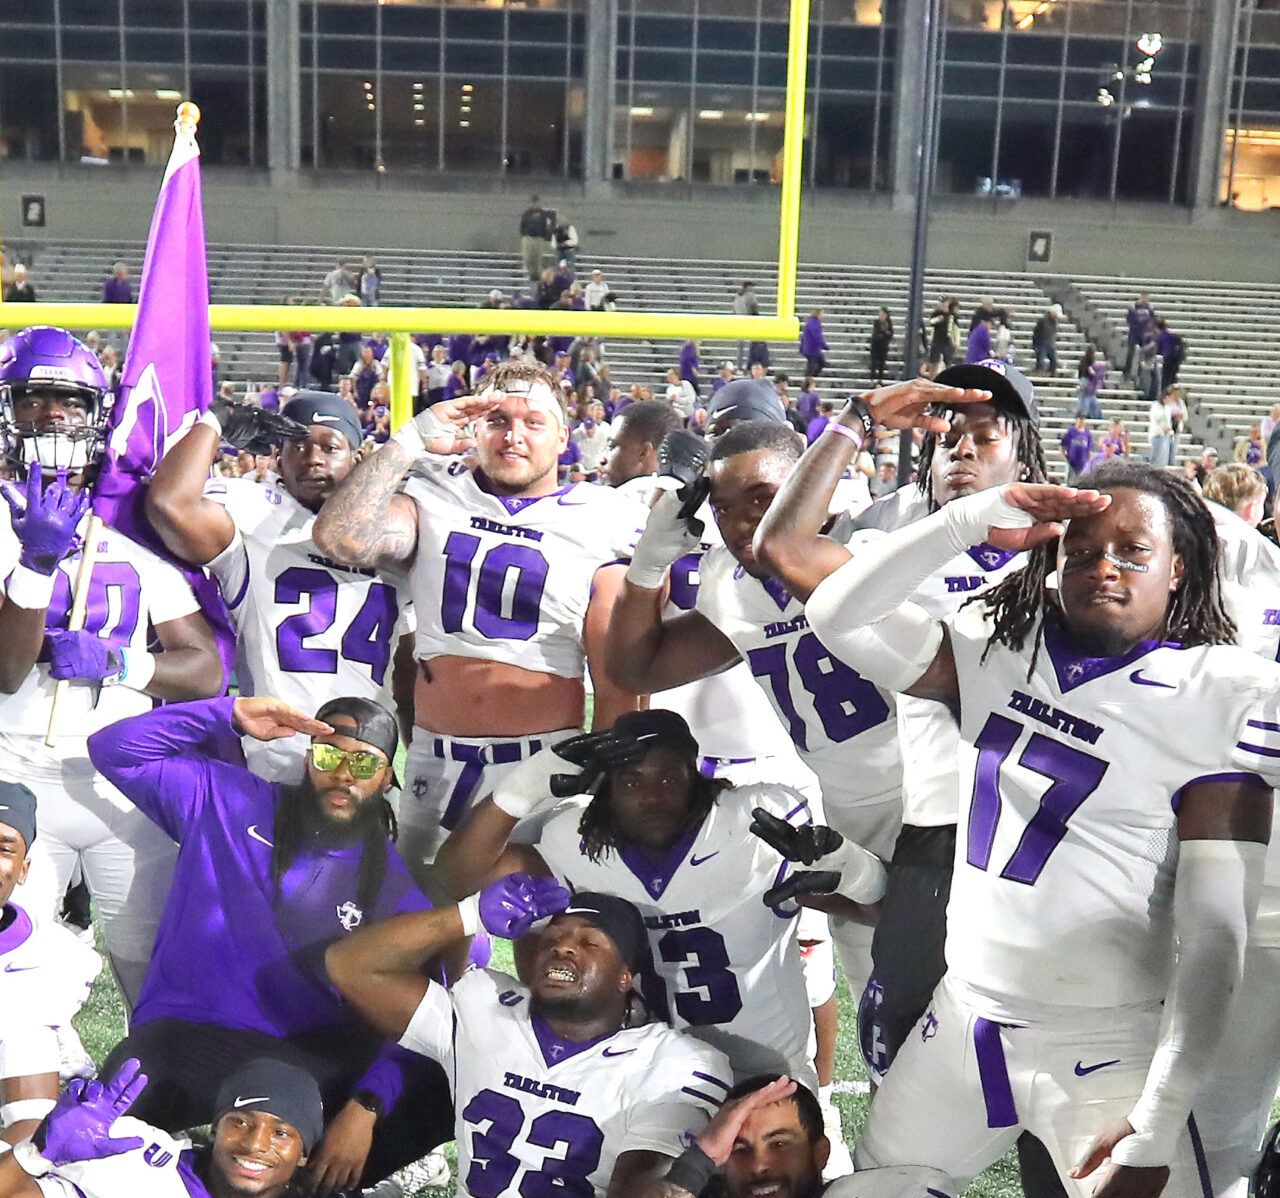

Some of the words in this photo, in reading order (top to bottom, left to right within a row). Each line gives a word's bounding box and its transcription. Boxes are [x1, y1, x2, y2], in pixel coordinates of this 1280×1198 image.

[470, 516, 544, 543] TARLETON
[442, 531, 550, 641] 10
[274, 566, 400, 687] 24
[764, 614, 811, 639] TARLET
[747, 632, 891, 753] 78
[1007, 689, 1105, 746] TARLETON
[966, 711, 1111, 886] 17
[644, 909, 702, 930] RLETON
[657, 926, 743, 1026] 3
[503, 1071, 582, 1107] TARLETON
